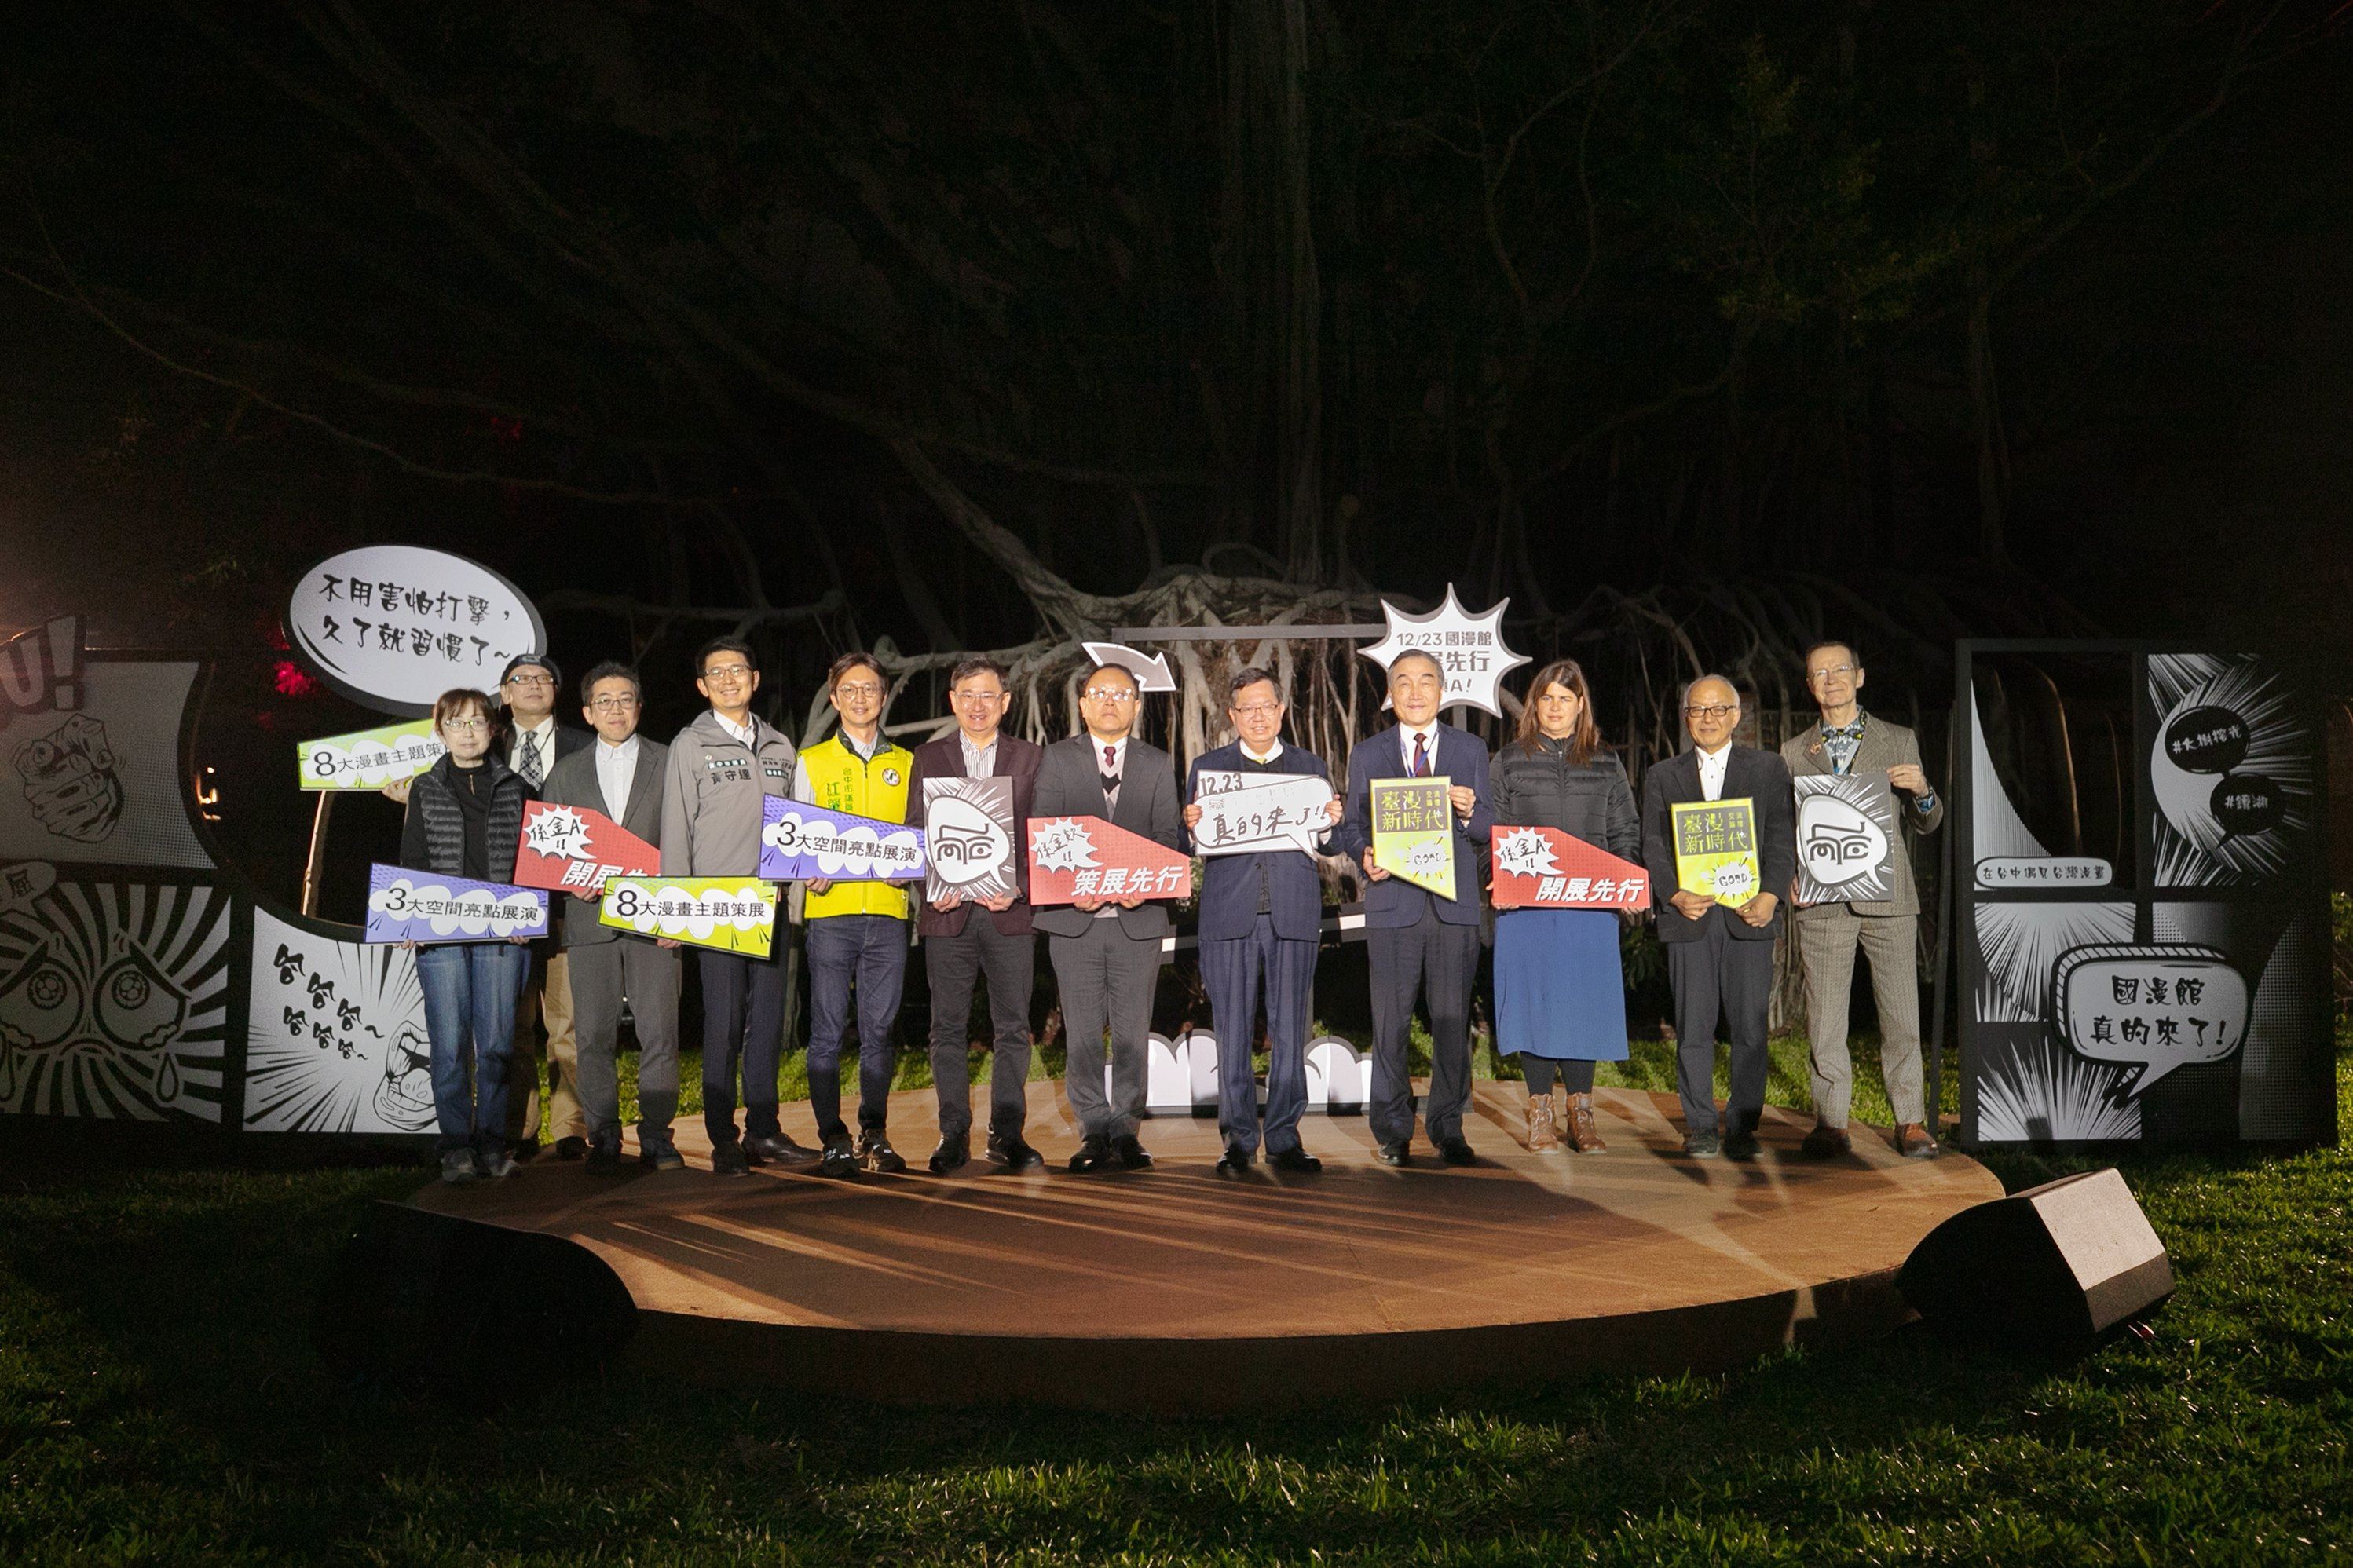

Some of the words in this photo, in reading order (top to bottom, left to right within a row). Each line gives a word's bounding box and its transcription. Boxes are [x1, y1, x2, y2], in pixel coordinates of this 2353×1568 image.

[1429, 650, 1490, 671] 先行
[1200, 773, 1244, 795] 12.23
[1382, 810, 1444, 831] 新時代
[777, 821, 917, 862] 3大空間亮點展演
[1685, 831, 1748, 853] 新時代
[1071, 866, 1184, 897] 策展先行
[1535, 876, 1645, 903] 開展先行
[385, 887, 539, 922] 3大空間亮點展演
[616, 890, 766, 918] 8大漫畫主題策展
[2111, 975, 2205, 1006] 國漫館
[2090, 1014, 2227, 1047] 真的來了!
